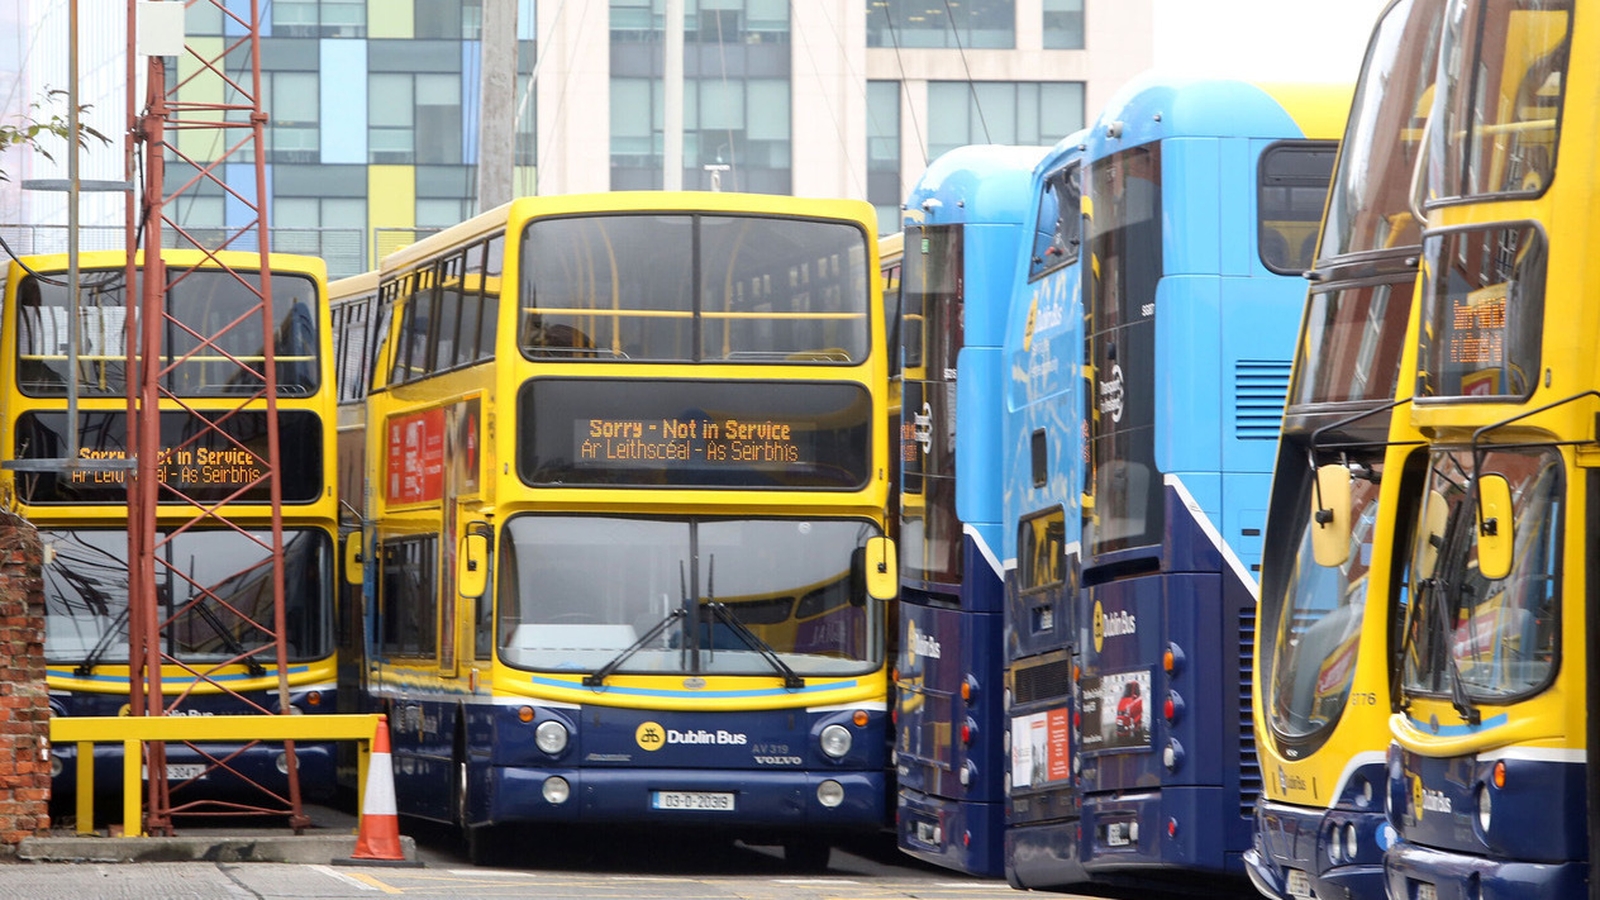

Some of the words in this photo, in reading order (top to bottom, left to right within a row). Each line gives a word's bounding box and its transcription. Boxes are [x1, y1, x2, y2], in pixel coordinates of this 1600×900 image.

[589, 419, 642, 438] Sorry
[663, 418, 697, 438] Not
[703, 419, 719, 439] in
[725, 419, 791, 440] Service
[177, 447, 192, 465] in
[197, 447, 254, 465] Service
[606, 439, 690, 460] Leithscéal
[706, 440, 727, 460] As
[181, 465, 199, 483] As
[667, 729, 716, 744] Dublin
[716, 729, 748, 745] Bus
[752, 744, 768, 755] AV
[770, 744, 789, 755] 319
[754, 756, 802, 765] VOLVO
